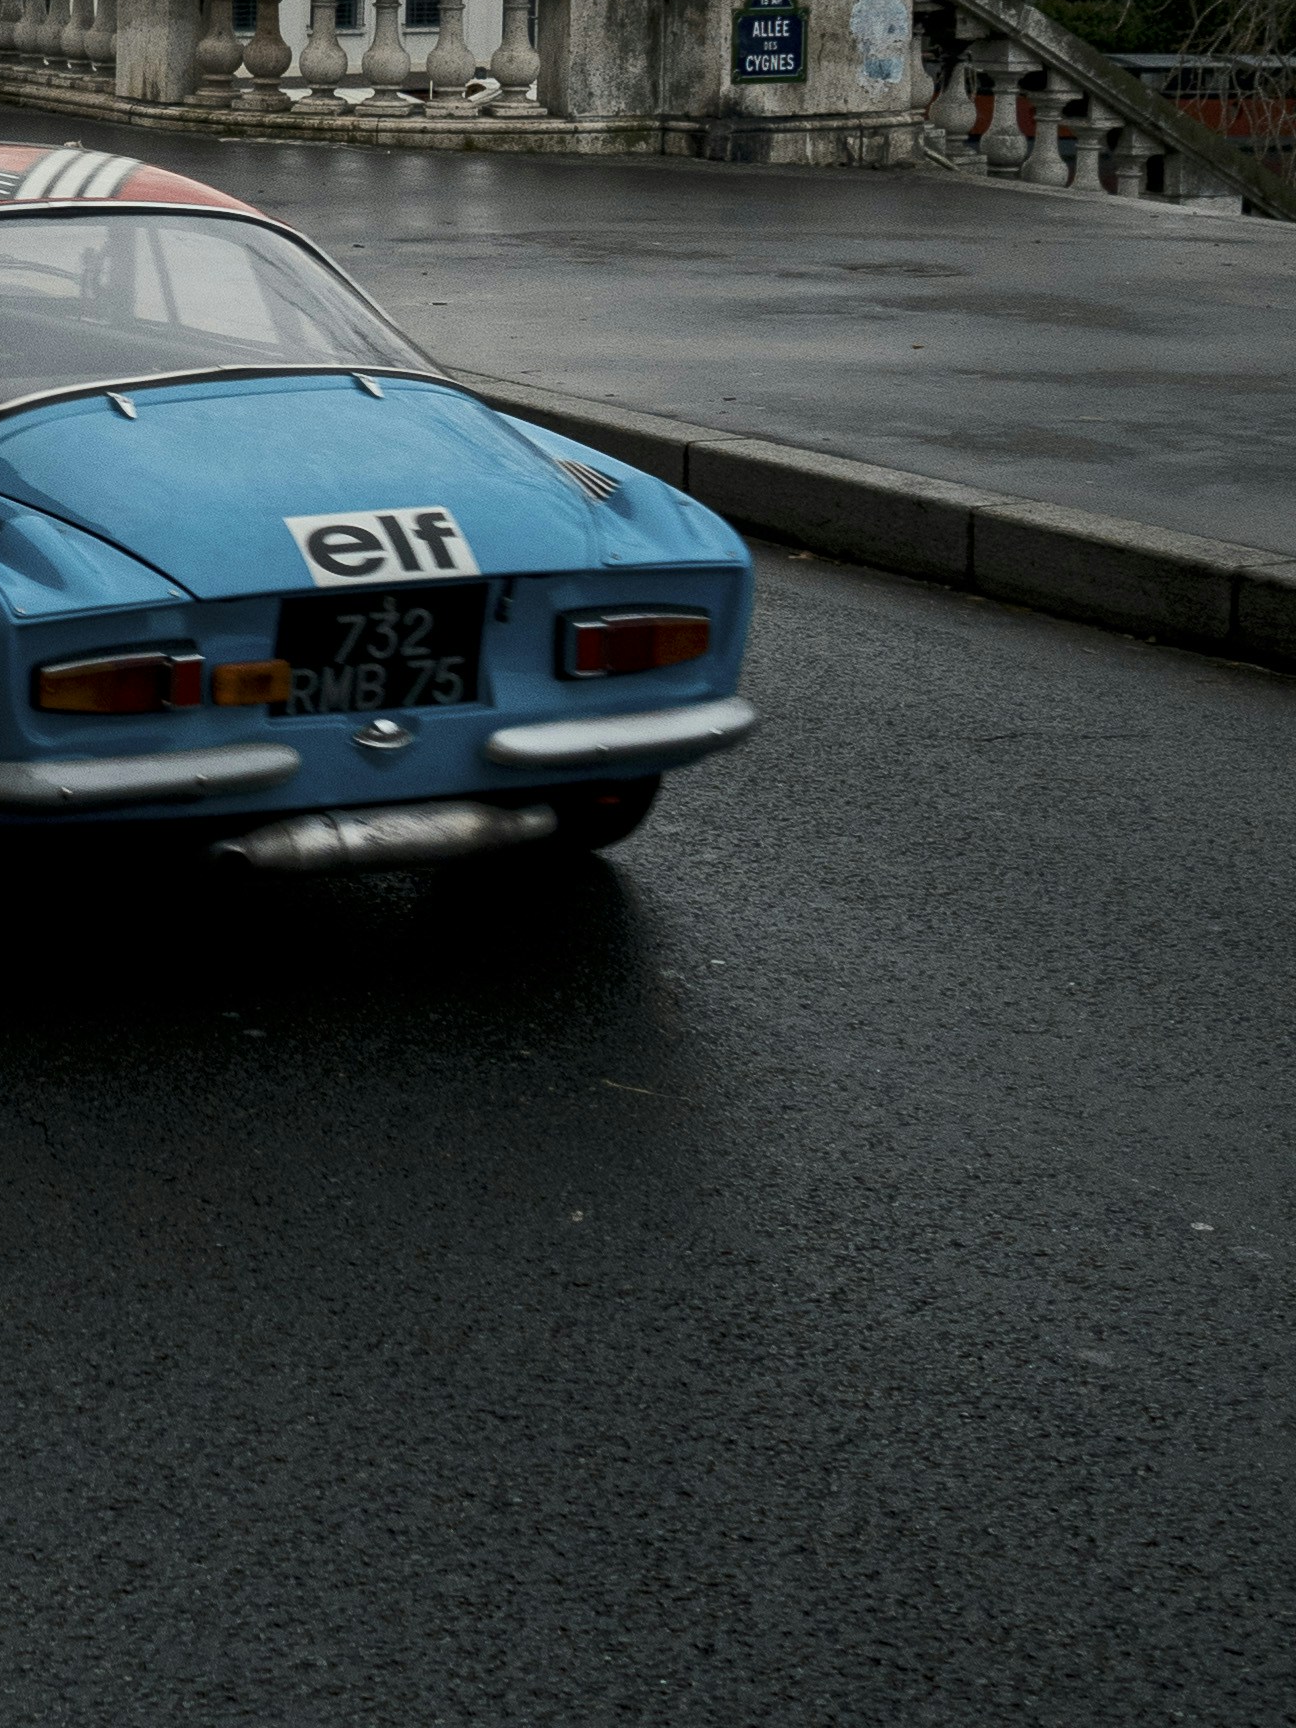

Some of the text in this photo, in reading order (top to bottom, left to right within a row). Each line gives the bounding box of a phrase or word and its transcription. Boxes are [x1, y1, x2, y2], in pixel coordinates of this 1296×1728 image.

[752, 16, 790, 37] ALLÉE
[746, 54, 794, 71] CYGNES
[764, 41, 778, 51] DES
[307, 511, 459, 578] elf
[334, 607, 435, 663] 732
[285, 655, 466, 716] RMB 75
